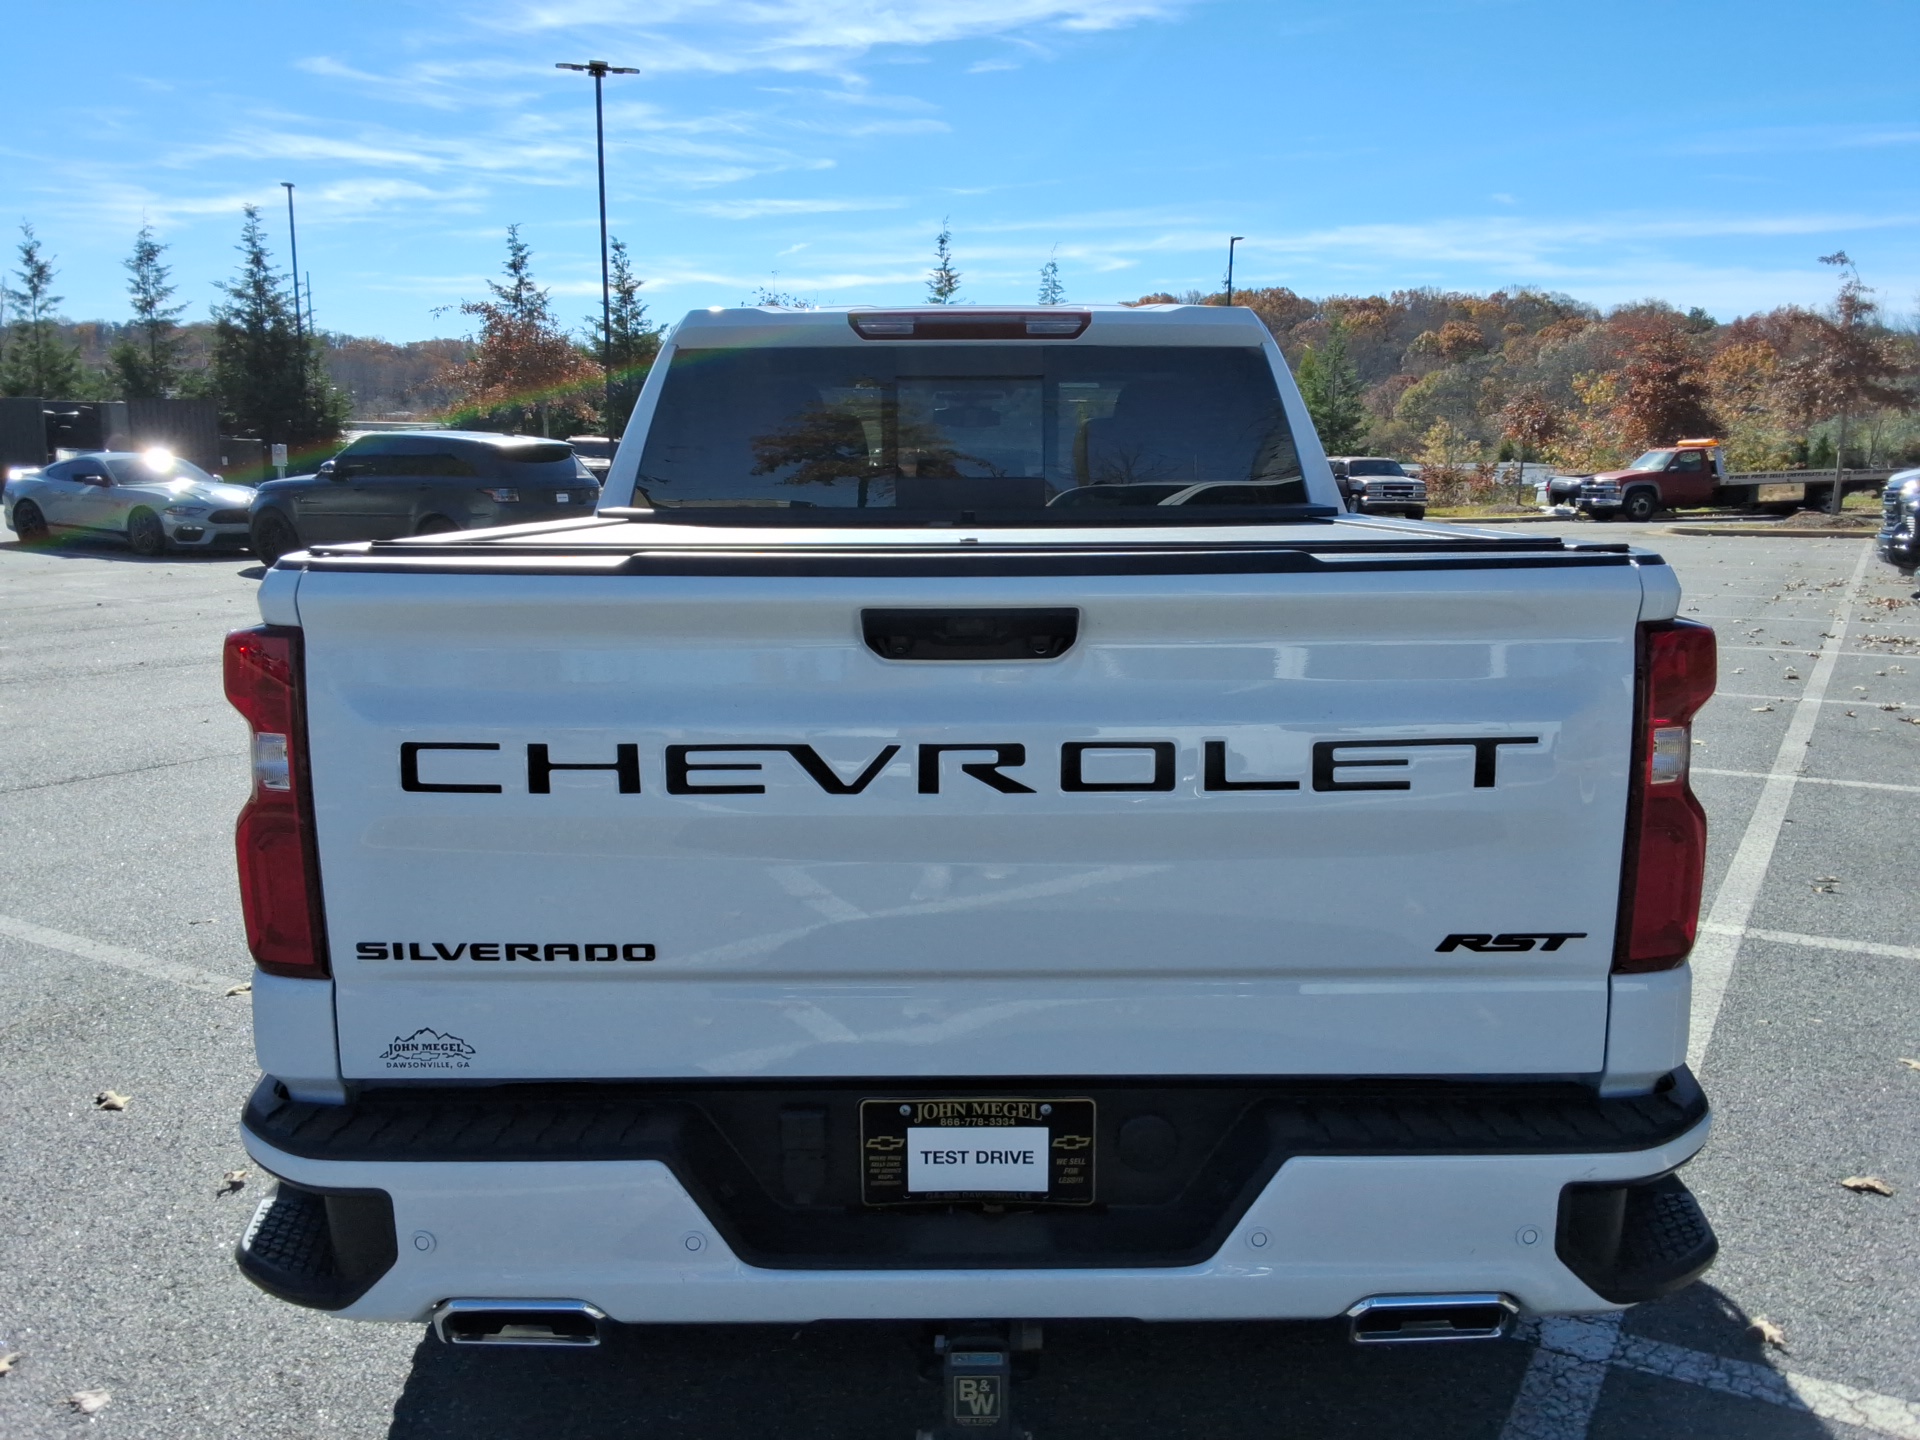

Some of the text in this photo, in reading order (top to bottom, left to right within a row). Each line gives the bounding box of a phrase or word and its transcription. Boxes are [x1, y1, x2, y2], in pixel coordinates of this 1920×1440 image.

[401, 737, 1538, 794] CHEVROLET
[1435, 933, 1587, 952] RST
[356, 943, 656, 961] SILVERADO
[388, 1043, 464, 1056] JOHN MEGEL
[386, 1061, 453, 1069] DAWSONVILLE,
[913, 1102, 1043, 1124] JOHN MEGEL
[940, 1118, 1016, 1126] 866-778-3334
[920, 1150, 1034, 1165] TEST DRIVE
[1056, 1157, 1086, 1166] WE SELL
[1063, 1167, 1079, 1175] FOR
